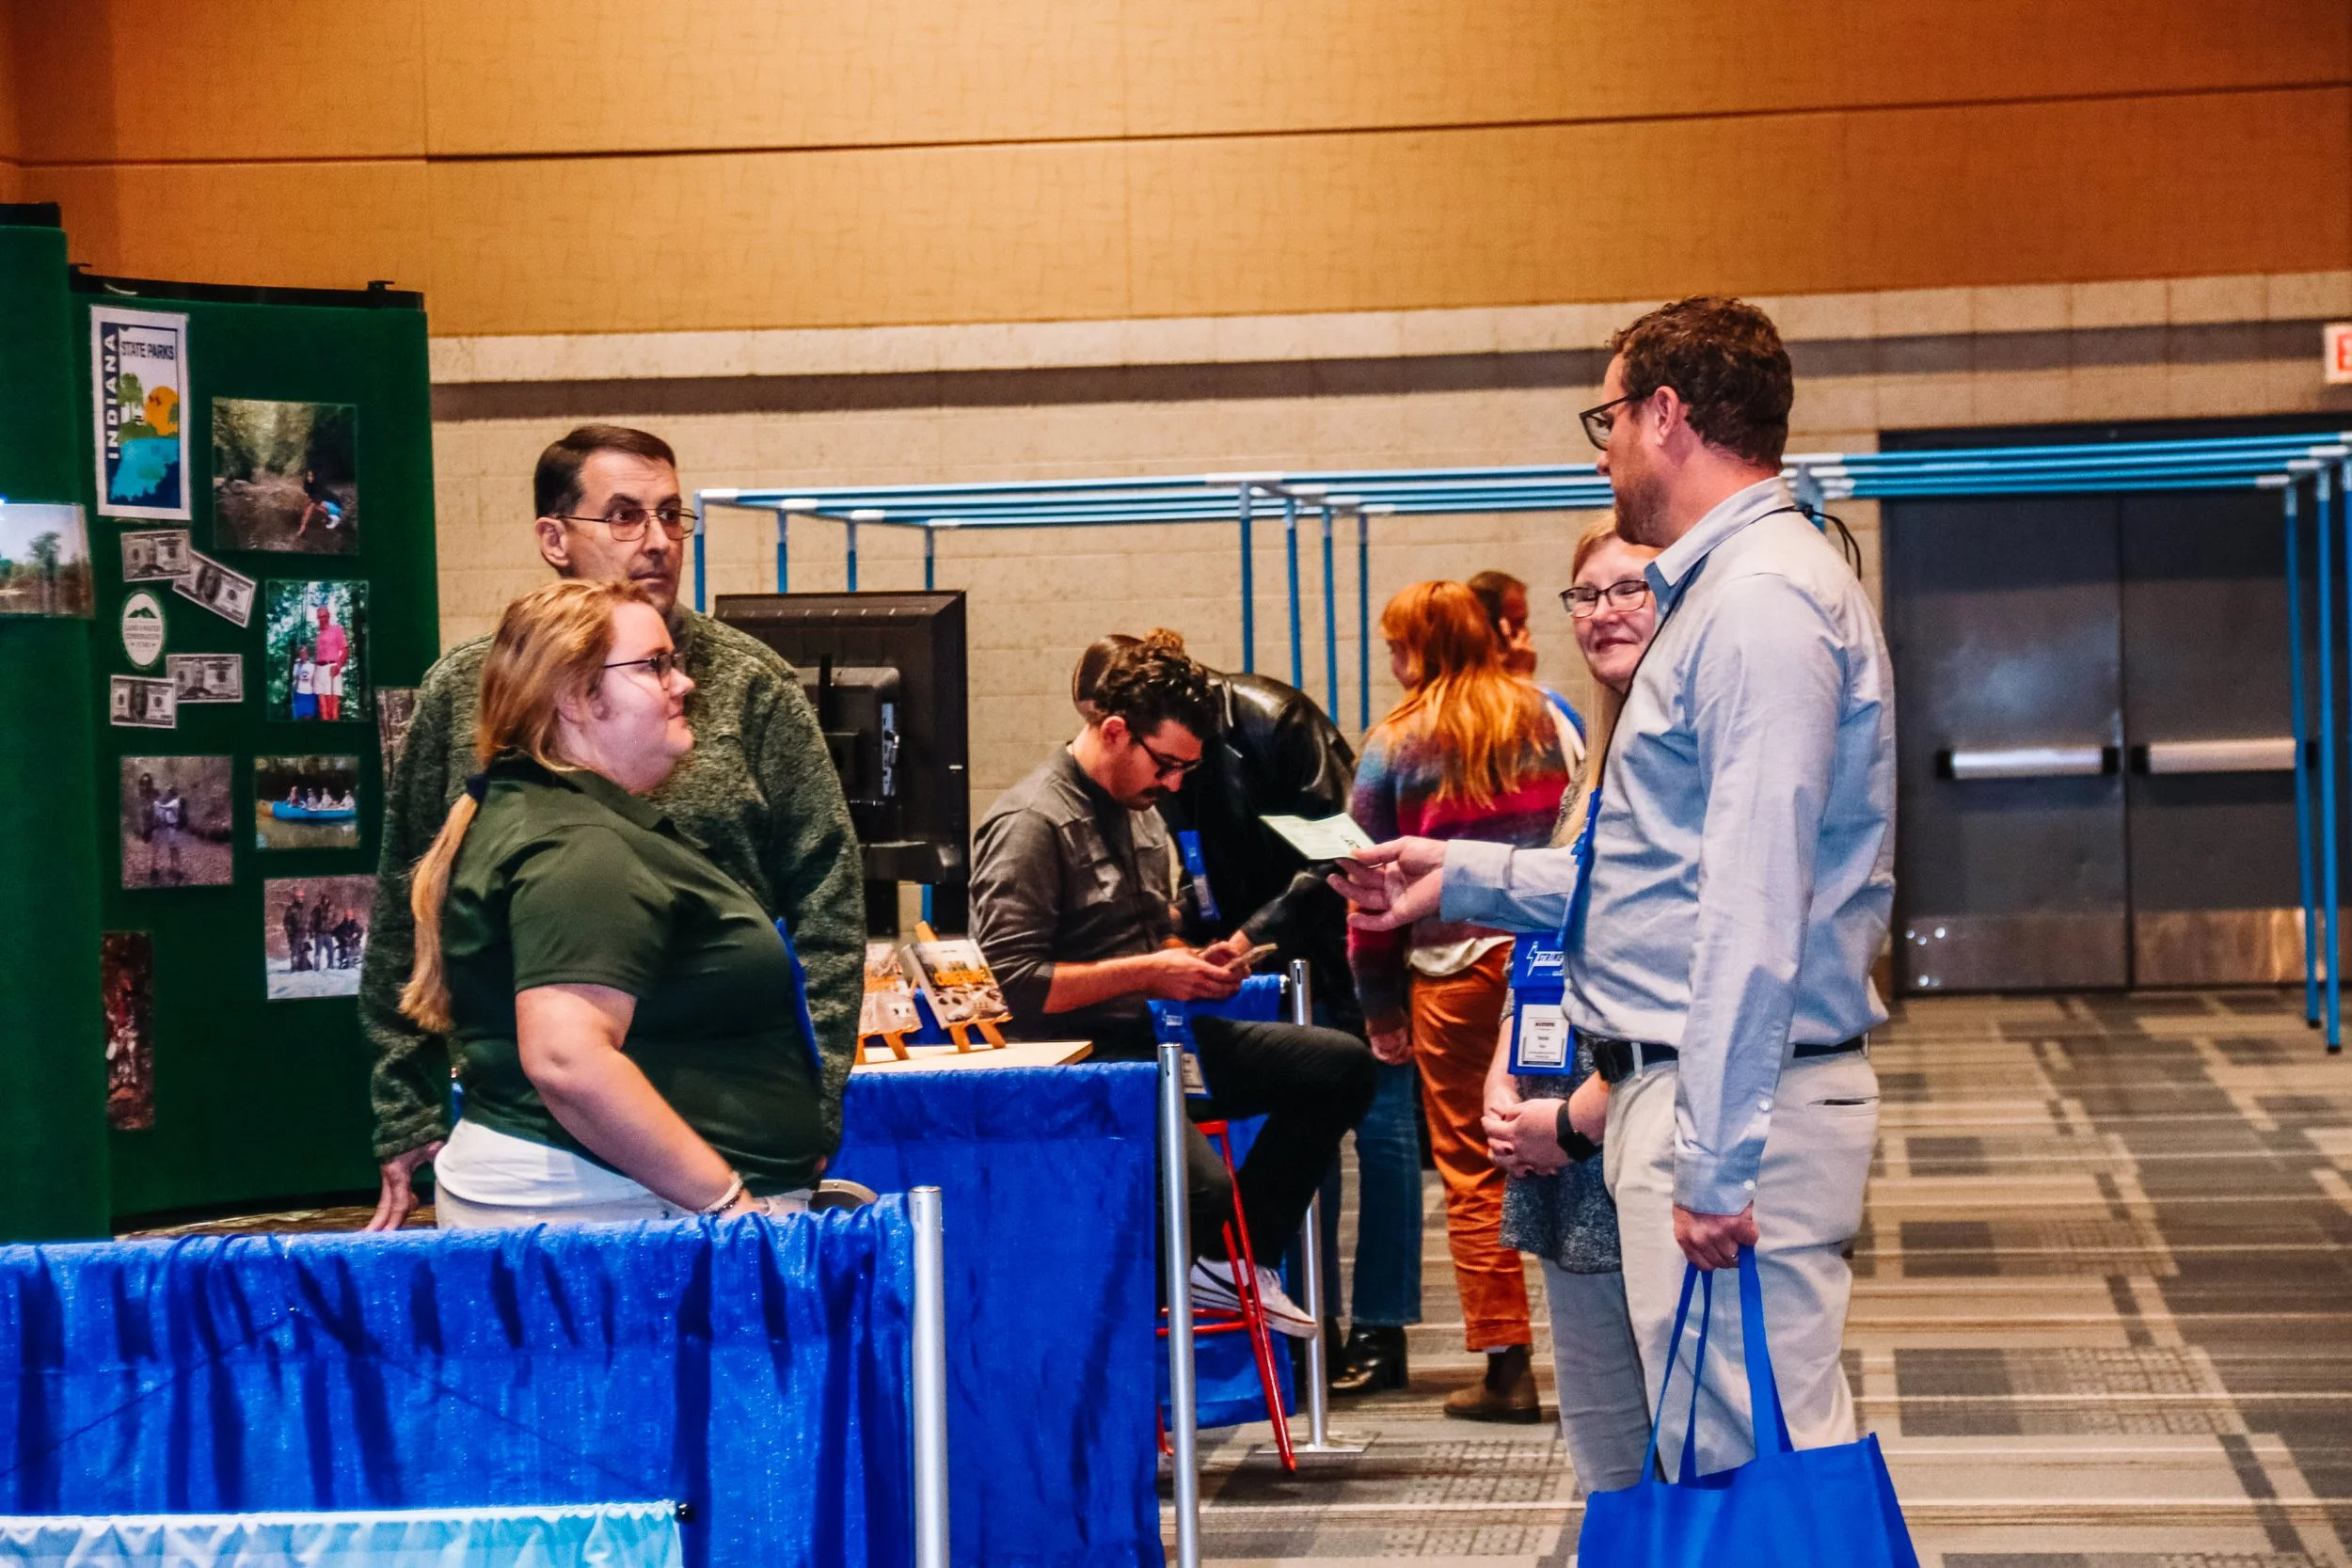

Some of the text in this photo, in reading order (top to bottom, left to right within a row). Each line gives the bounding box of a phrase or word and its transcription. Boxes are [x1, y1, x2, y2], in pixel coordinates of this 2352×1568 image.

[120, 341, 174, 360] STATE PARKS
[103, 333, 120, 460] INDIANA
